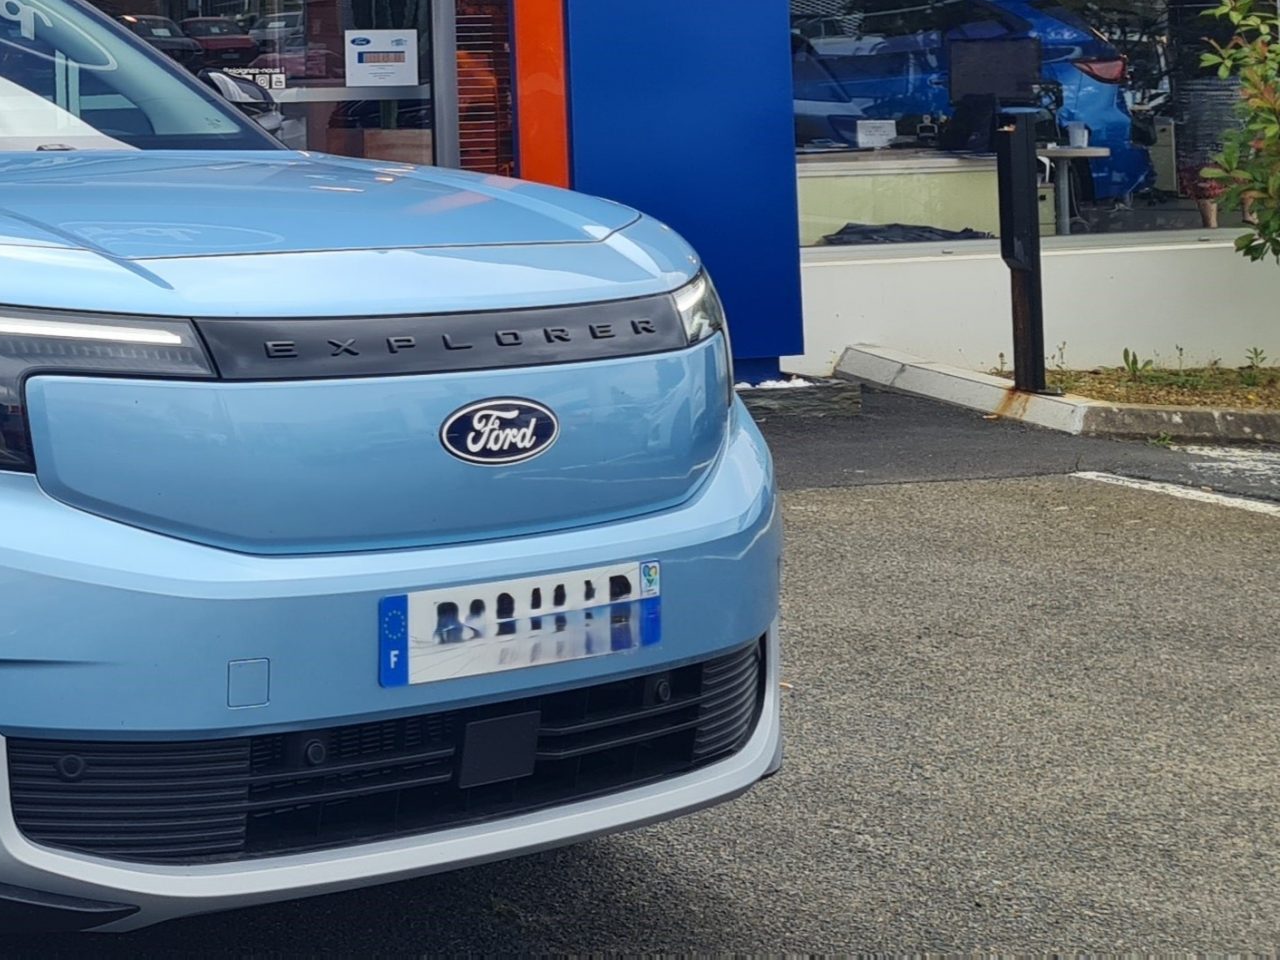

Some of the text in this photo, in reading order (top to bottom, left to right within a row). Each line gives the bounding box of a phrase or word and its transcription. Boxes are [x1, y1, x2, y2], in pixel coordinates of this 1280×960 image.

[264, 318, 656, 359] EXPLORER
[465, 409, 537, 453] Ford
[389, 650, 400, 670] F
